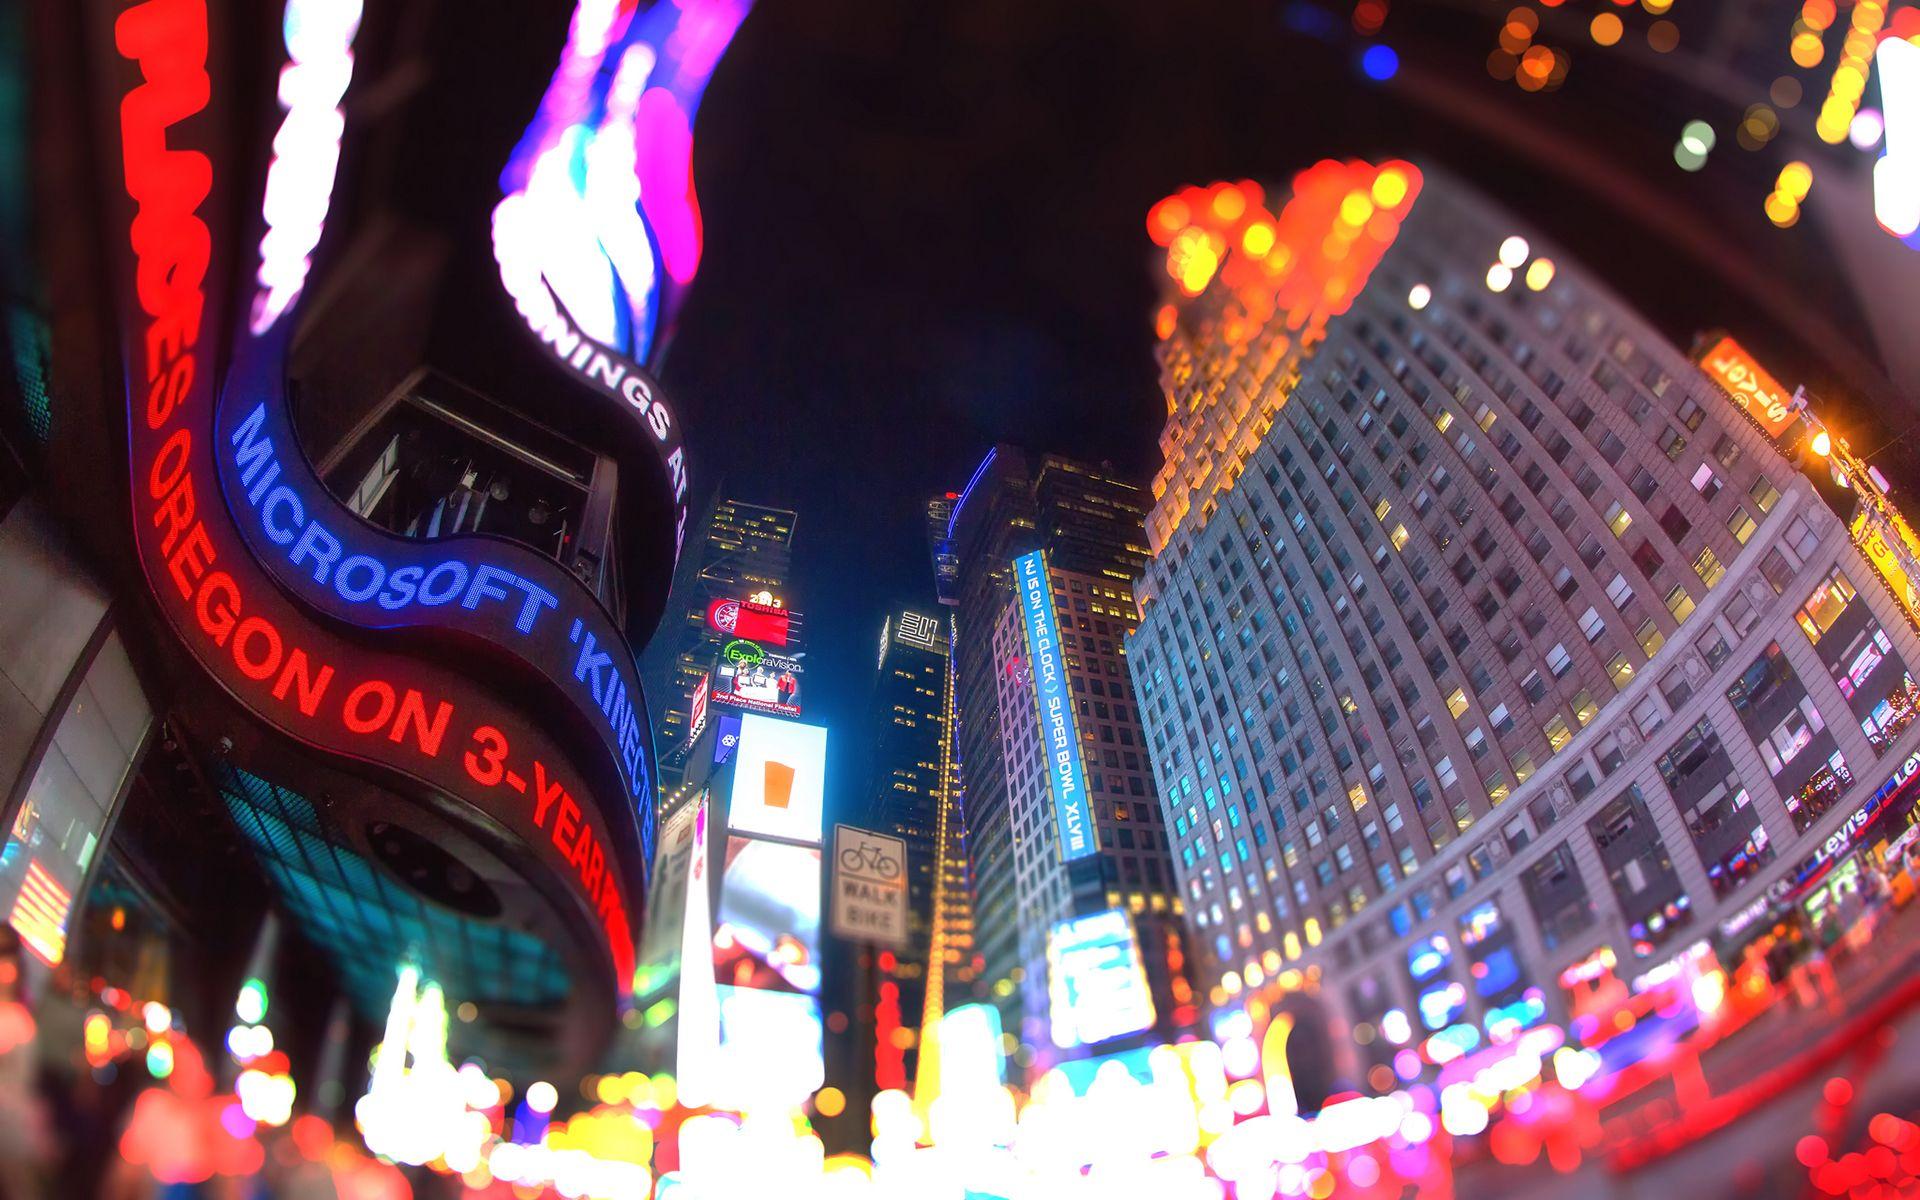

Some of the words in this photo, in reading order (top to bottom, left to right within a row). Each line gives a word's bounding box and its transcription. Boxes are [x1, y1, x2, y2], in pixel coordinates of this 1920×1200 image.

[667, 446, 688, 503] AT
[232, 402, 558, 634] MICROSOFT
[1024, 558, 1037, 576] NJ
[1027, 577, 1040, 590] IS
[740, 600, 789, 617] TOSHIBA
[1030, 591, 1043, 610] ON
[1033, 610, 1048, 638] THE
[149, 428, 334, 717] OREGON
[343, 680, 454, 757] ON
[464, 725, 604, 895] 3-YEAR
[730, 648, 803, 674] ExploraVision
[1038, 638, 1057, 684] CLOCK
[716, 692, 729, 701] 2nd
[729, 694, 747, 704] Place
[748, 697, 774, 708] National
[1048, 696, 1068, 750] SUPER
[1056, 750, 1076, 800] BOWL
[1065, 801, 1086, 851] XLVIII
[842, 880, 897, 906] WALK
[846, 904, 892, 929] BIKE
